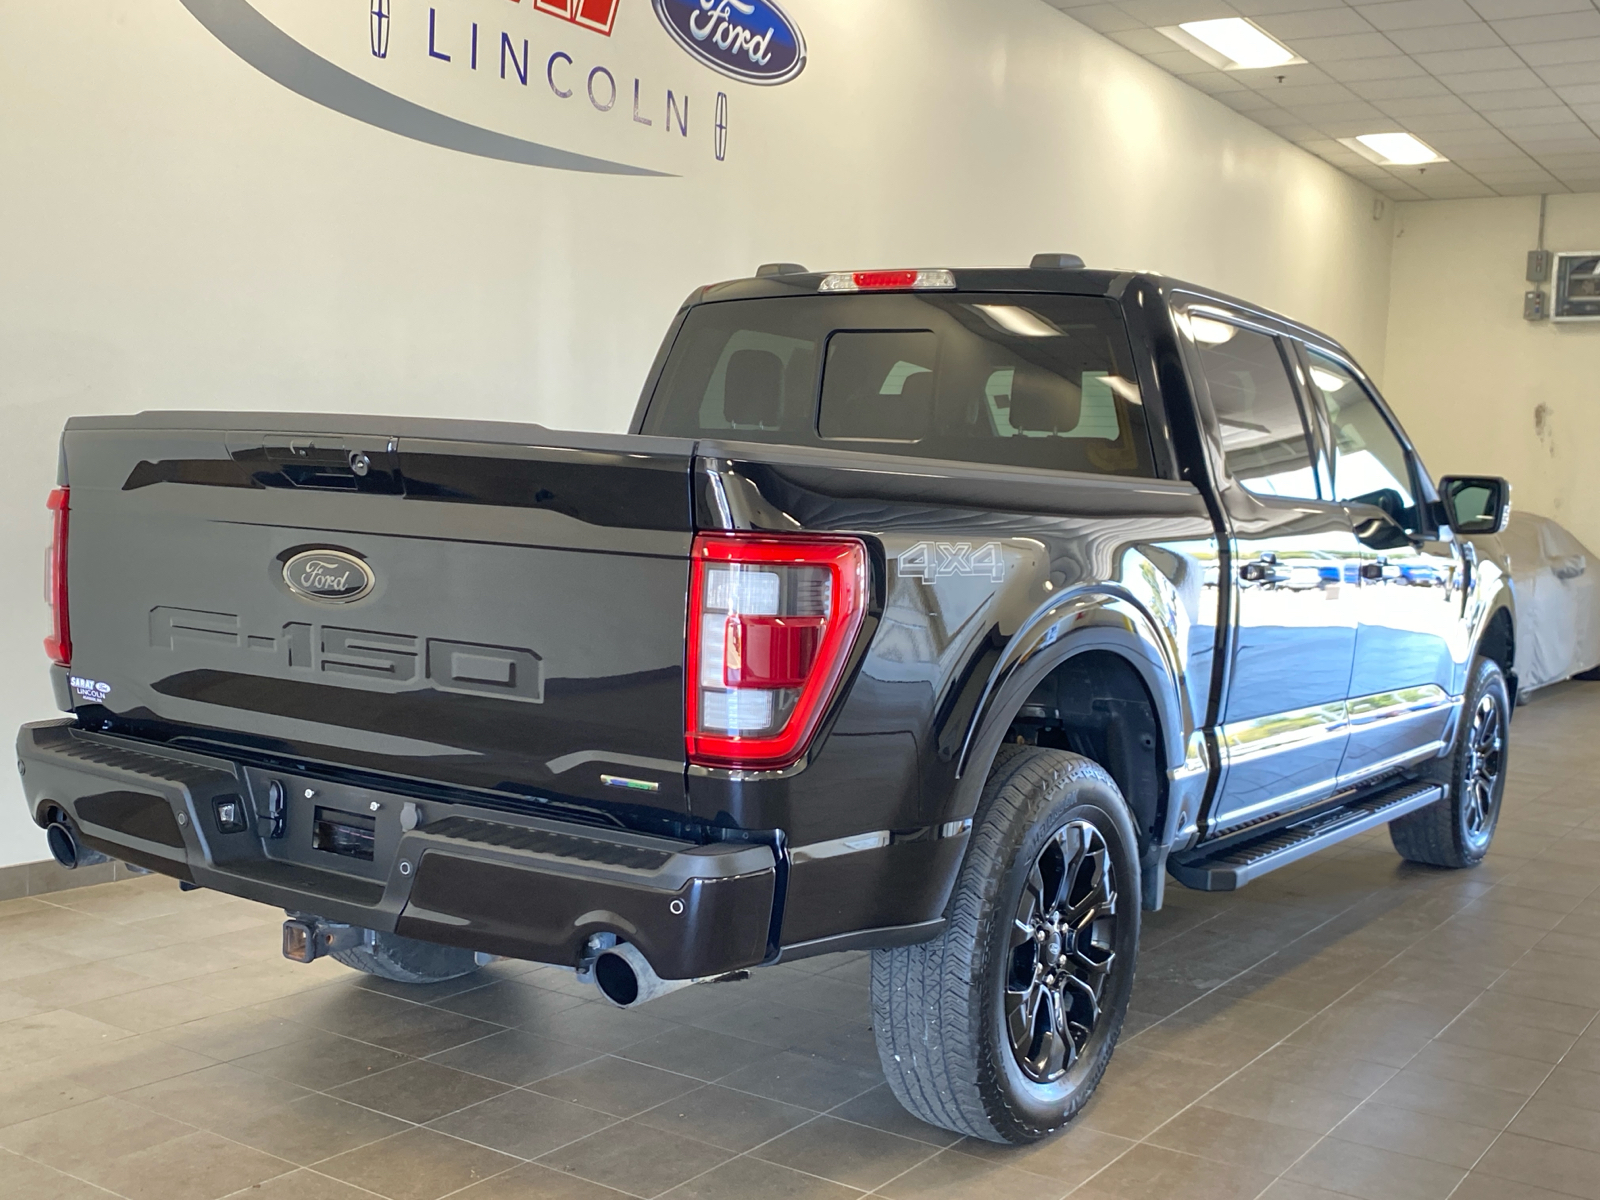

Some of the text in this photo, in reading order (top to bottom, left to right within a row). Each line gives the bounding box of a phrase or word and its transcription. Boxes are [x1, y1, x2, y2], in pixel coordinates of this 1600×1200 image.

[689, 0, 774, 66] Ford
[428, 7, 689, 138] LINCOLN
[301, 560, 350, 591] Ford
[149, 605, 544, 704] F-150
[77, 687, 106, 699] LINCOLN
